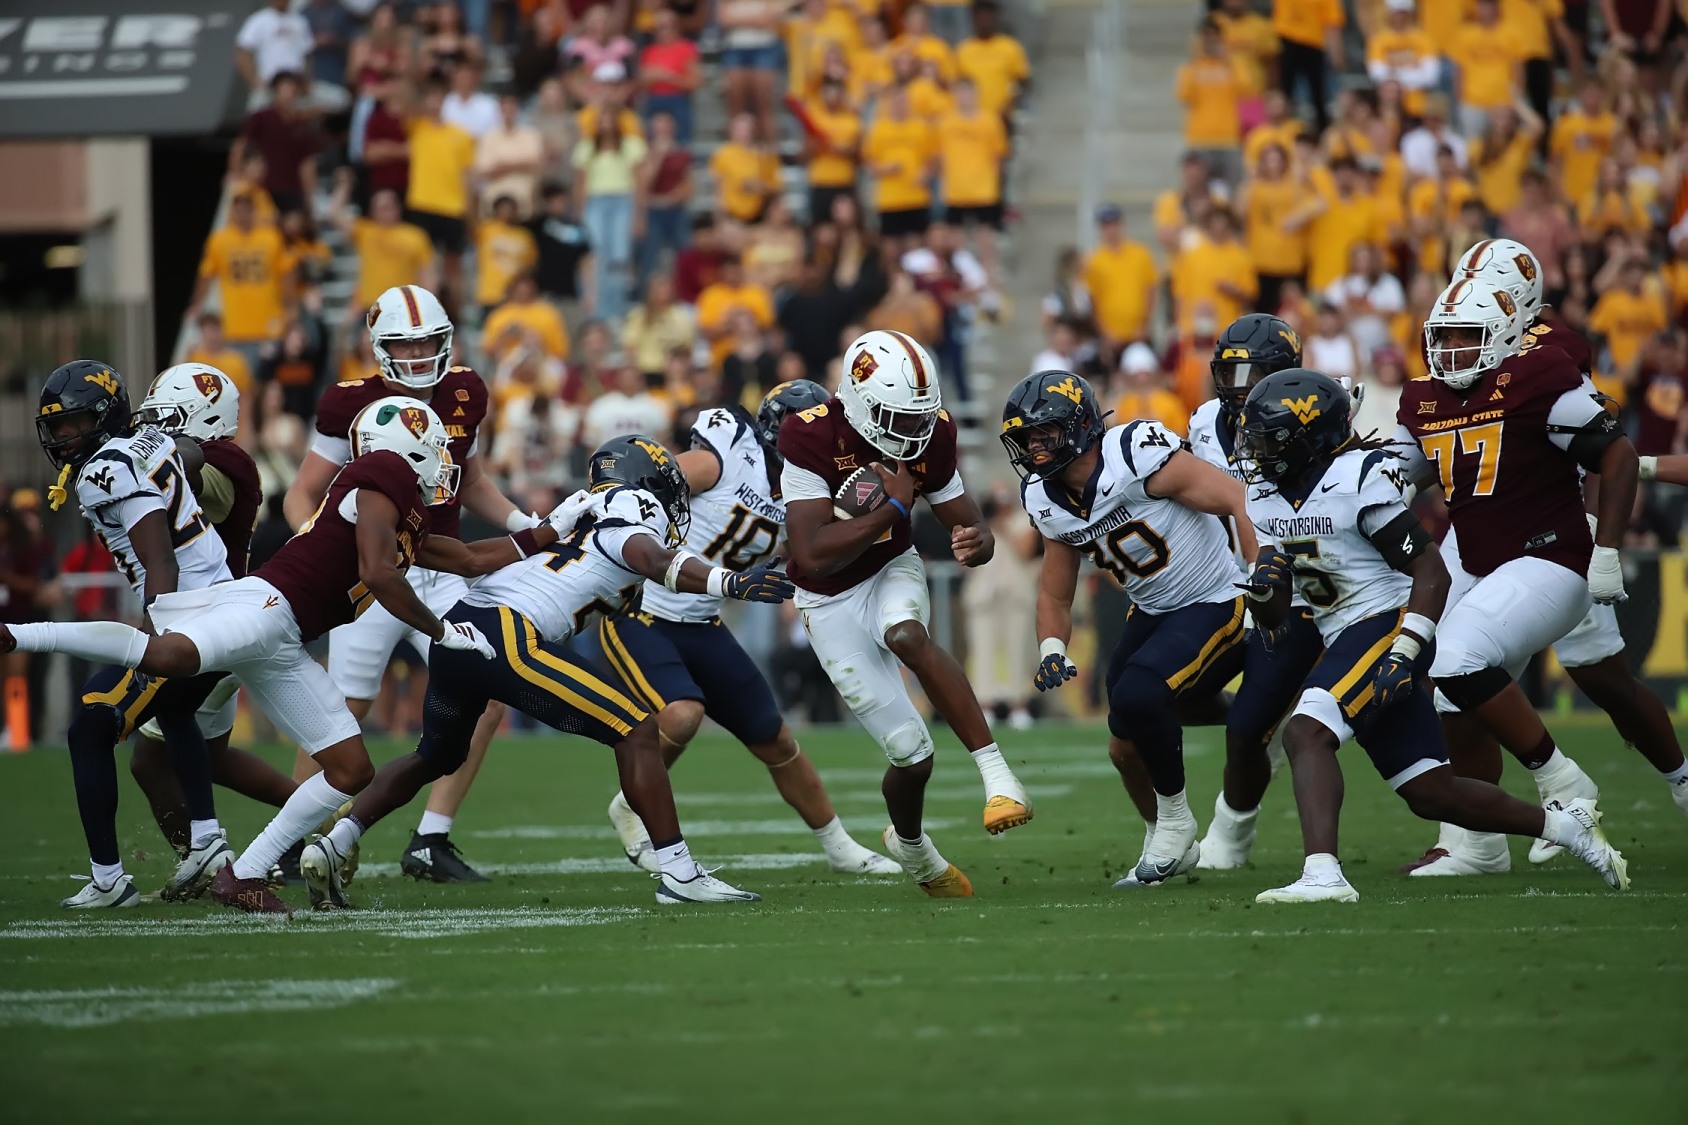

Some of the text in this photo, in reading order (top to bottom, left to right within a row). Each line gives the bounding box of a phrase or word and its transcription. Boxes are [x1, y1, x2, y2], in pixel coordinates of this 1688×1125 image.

[406, 409, 420, 419] PT
[1417, 409, 1504, 431] ARIZONA STATE
[410, 421, 423, 432] 42
[1419, 420, 1504, 502] 77
[734, 482, 764, 511] WEST
[1268, 516, 1334, 537] WEST VIRGINIA
